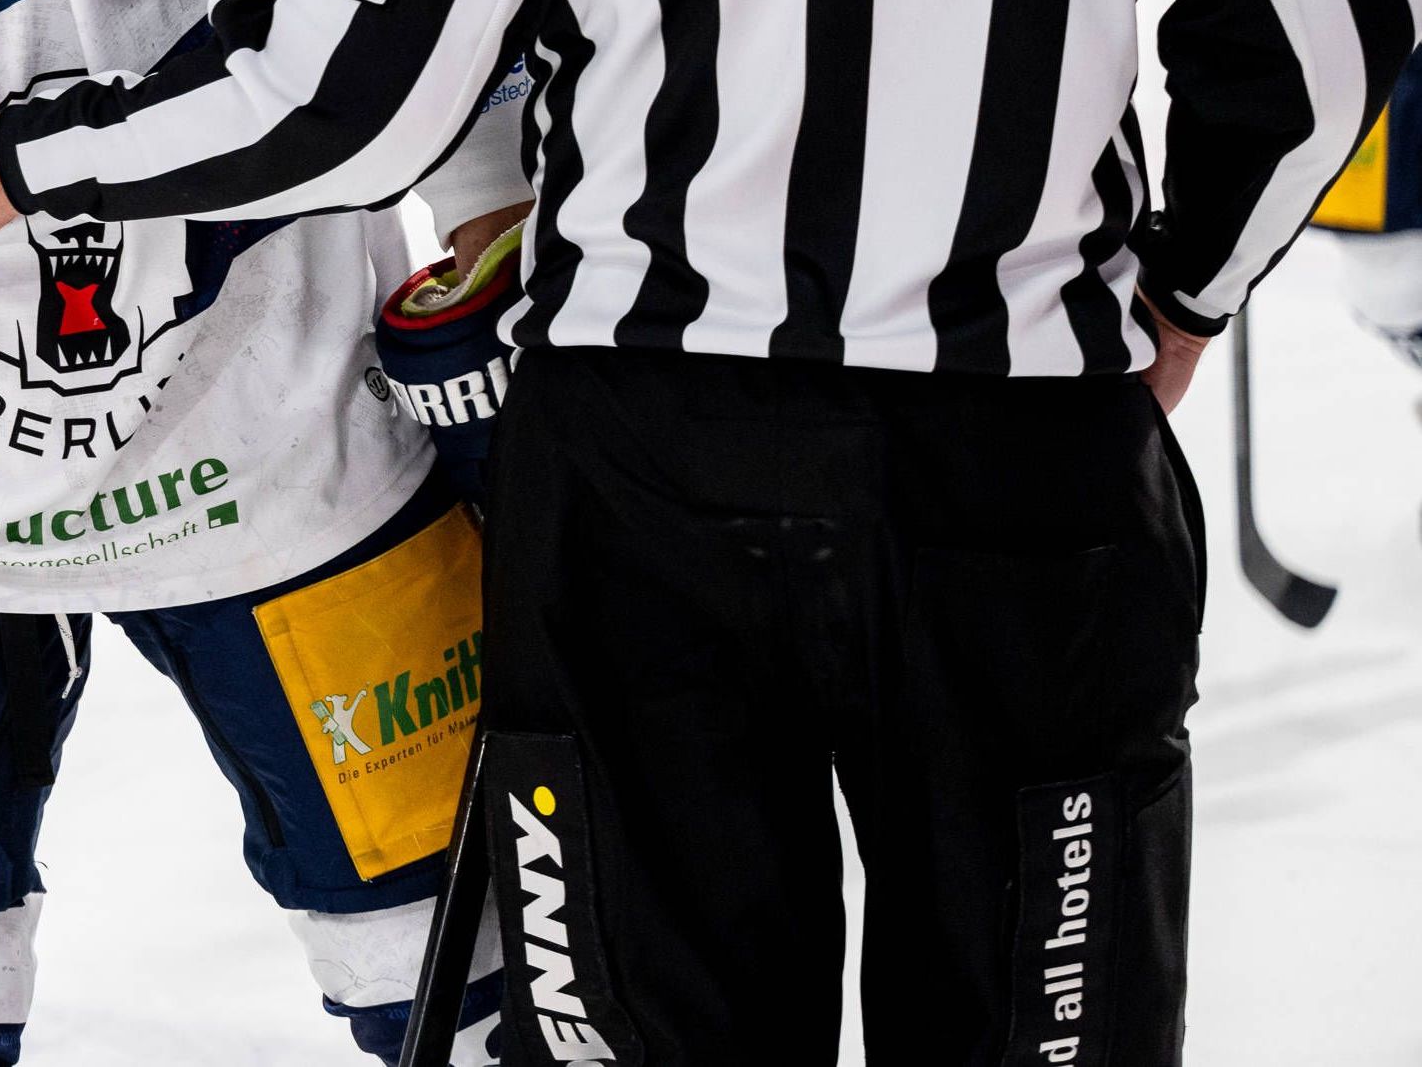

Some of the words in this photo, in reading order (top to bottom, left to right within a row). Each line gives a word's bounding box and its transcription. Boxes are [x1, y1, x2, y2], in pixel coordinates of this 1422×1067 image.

[339, 770, 359, 784] Die
[366, 743, 423, 774] Experten
[1045, 793, 1093, 949] hotels
[1044, 962, 1083, 1022] all
